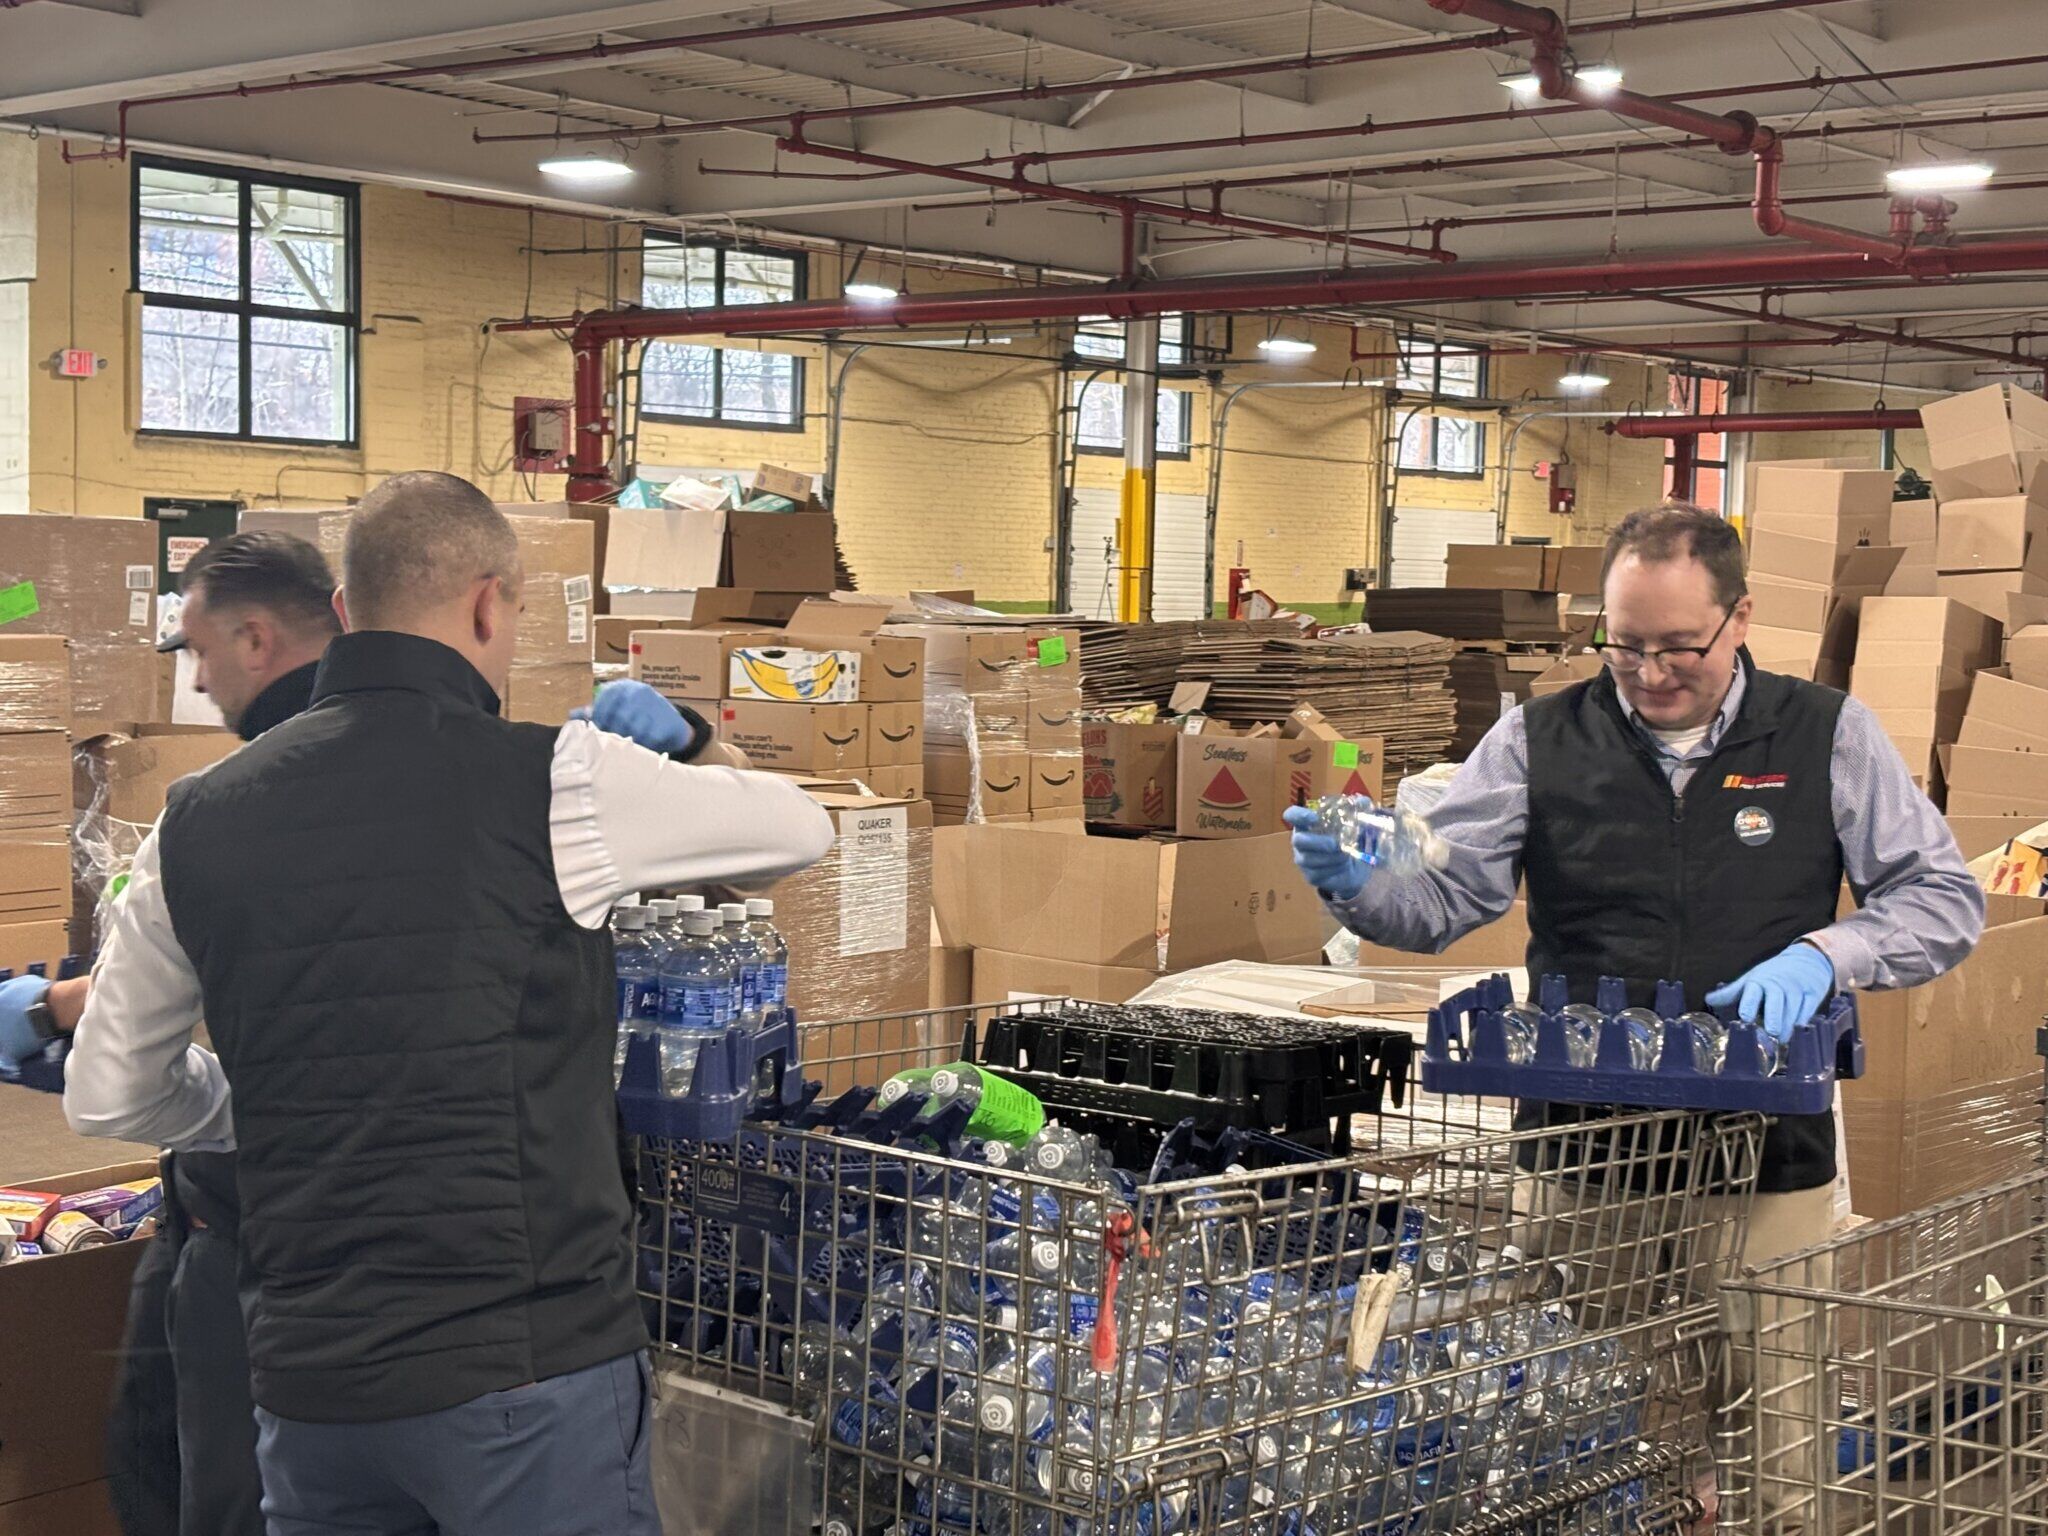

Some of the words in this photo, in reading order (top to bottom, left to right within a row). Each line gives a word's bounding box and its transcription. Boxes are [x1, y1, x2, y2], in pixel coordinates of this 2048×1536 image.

[1203, 744, 1248, 762] Seedless
[858, 818, 892, 830] QUAKER
[780, 1191, 790, 1218] 4
